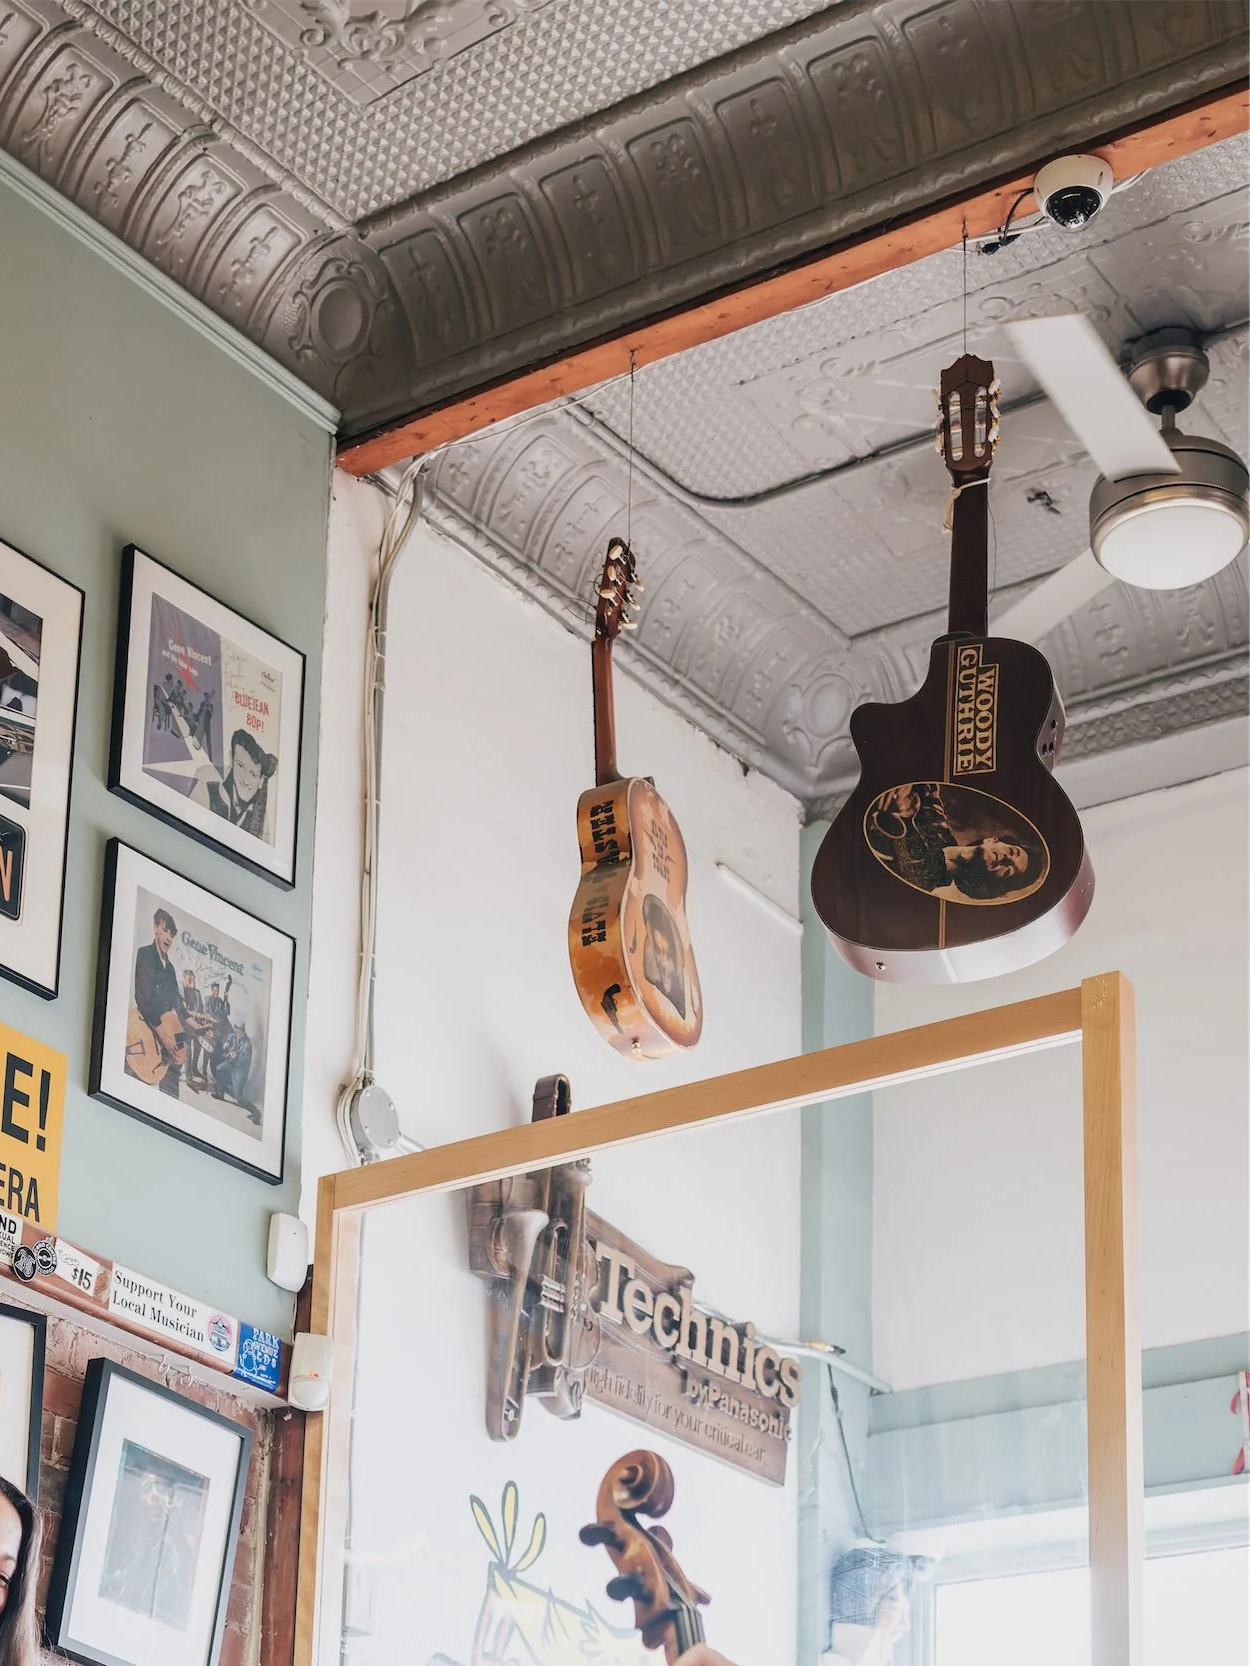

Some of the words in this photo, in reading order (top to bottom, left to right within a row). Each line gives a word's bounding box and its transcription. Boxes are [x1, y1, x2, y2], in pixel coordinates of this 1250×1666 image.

[186, 646, 214, 668] Vincent
[246, 712, 265, 734] BOP!
[959, 646, 981, 775] GUTHRIE
[976, 665, 1000, 773] WOODY
[181, 930, 208, 957] Gene
[206, 941, 245, 977] Vincent
[71, 1267, 93, 1291] $15
[114, 1270, 164, 1307] Support
[168, 1290, 197, 1319] Your
[113, 1290, 146, 1318] Local
[149, 1308, 205, 1344] Musician
[596, 1240, 804, 1407] Technics
[614, 1370, 653, 1409] fidelity
[652, 1393, 674, 1418] for
[673, 1404, 703, 1434] your
[703, 1415, 745, 1453] critical
[709, 1377, 793, 1441] Panasonic
